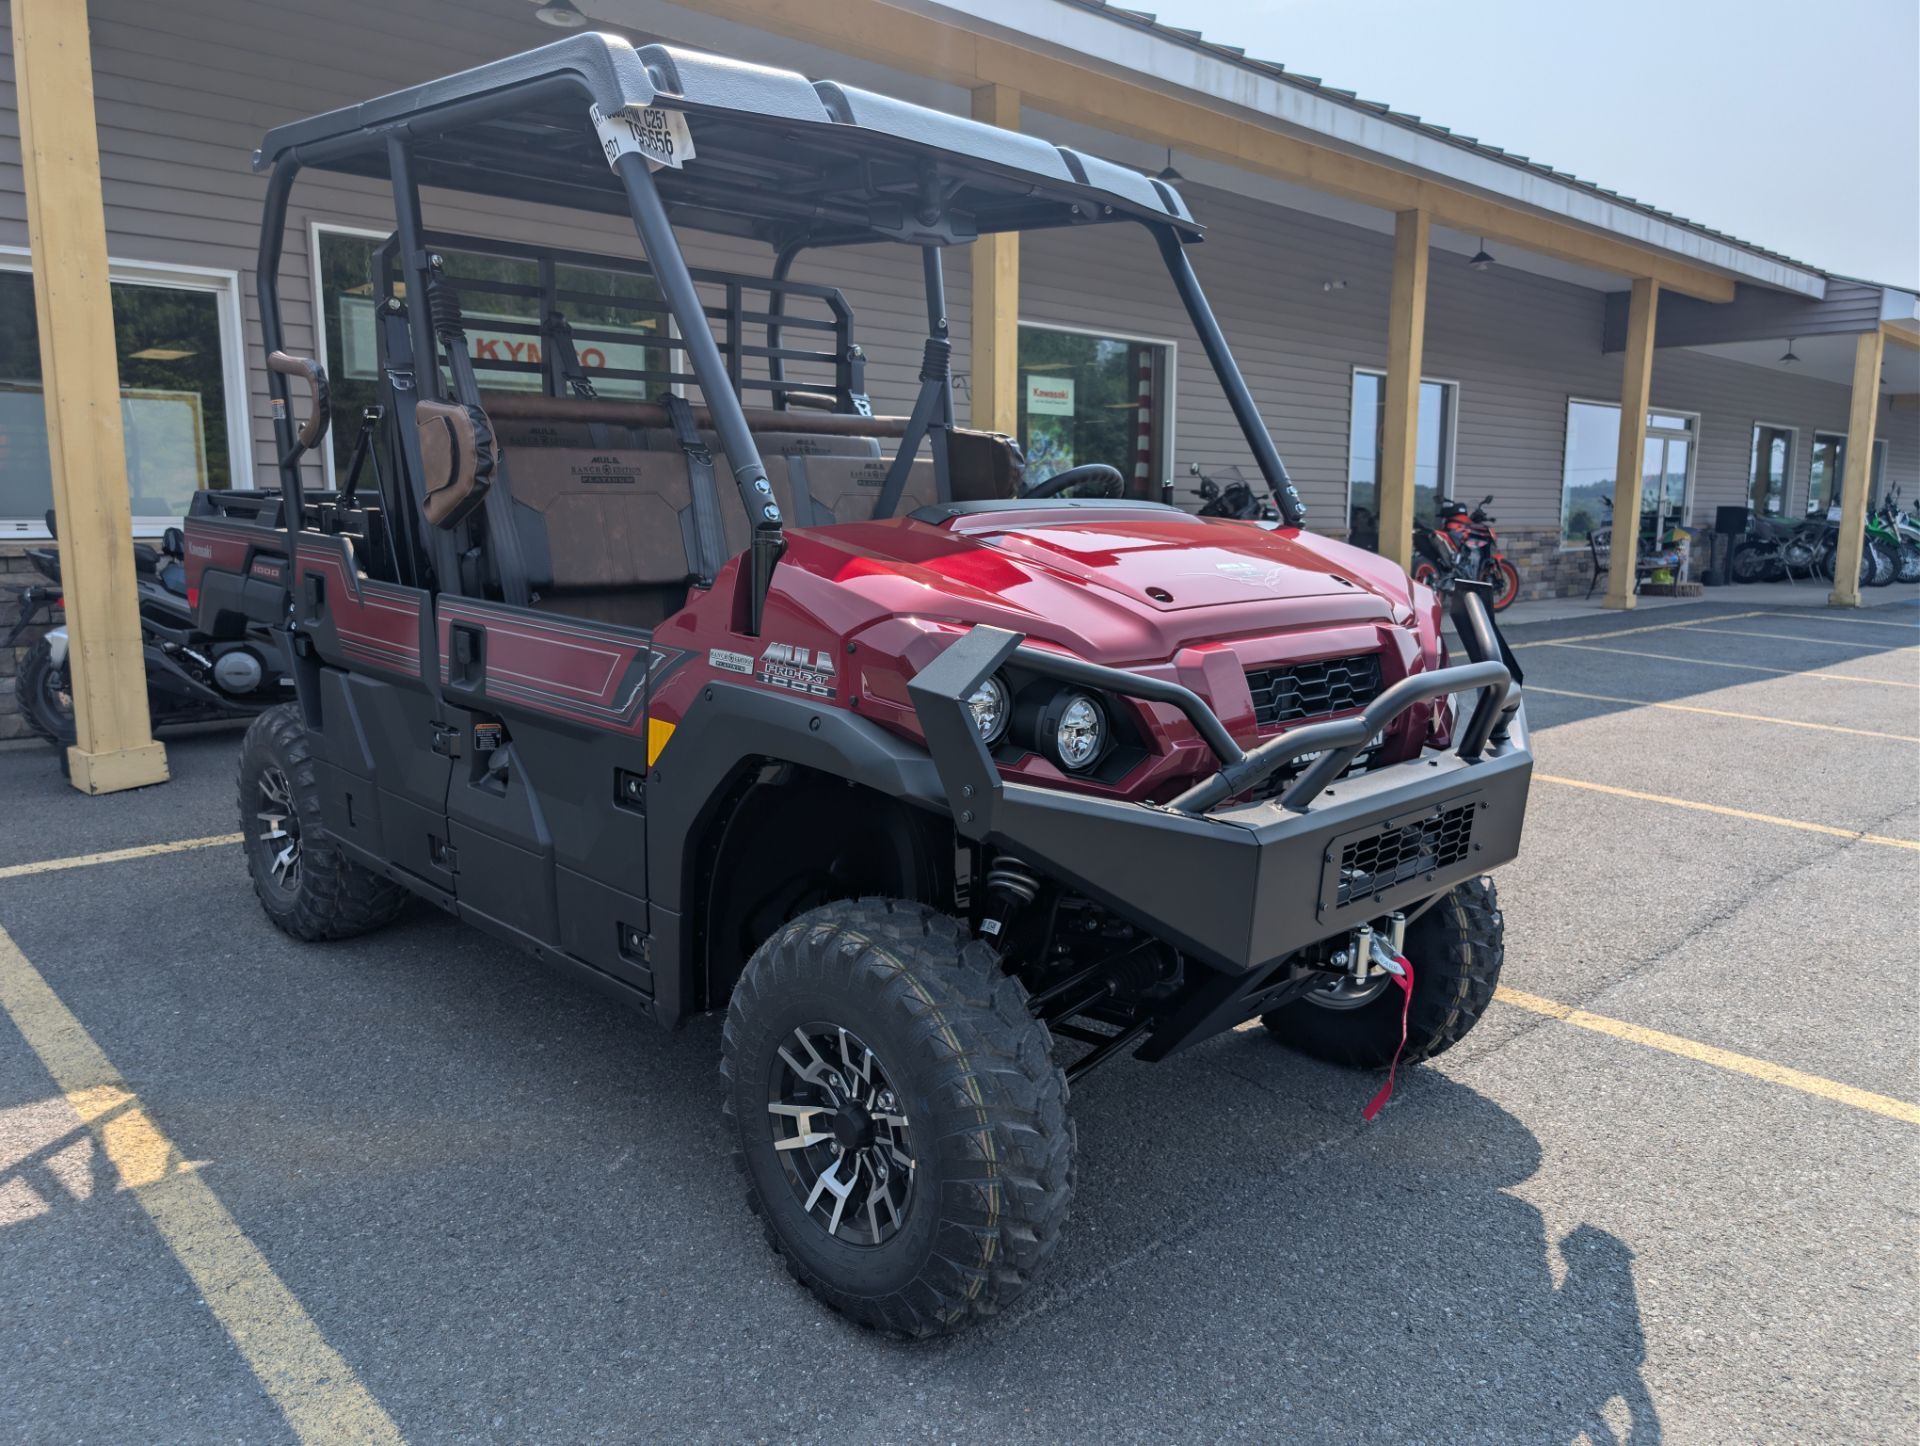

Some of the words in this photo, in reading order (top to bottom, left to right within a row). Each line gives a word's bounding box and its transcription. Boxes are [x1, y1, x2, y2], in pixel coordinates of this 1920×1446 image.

[643, 109, 668, 129] C251
[625, 119, 674, 155] T95656
[253, 565, 279, 577] 1000
[764, 663, 829, 685] PRO-FXT
